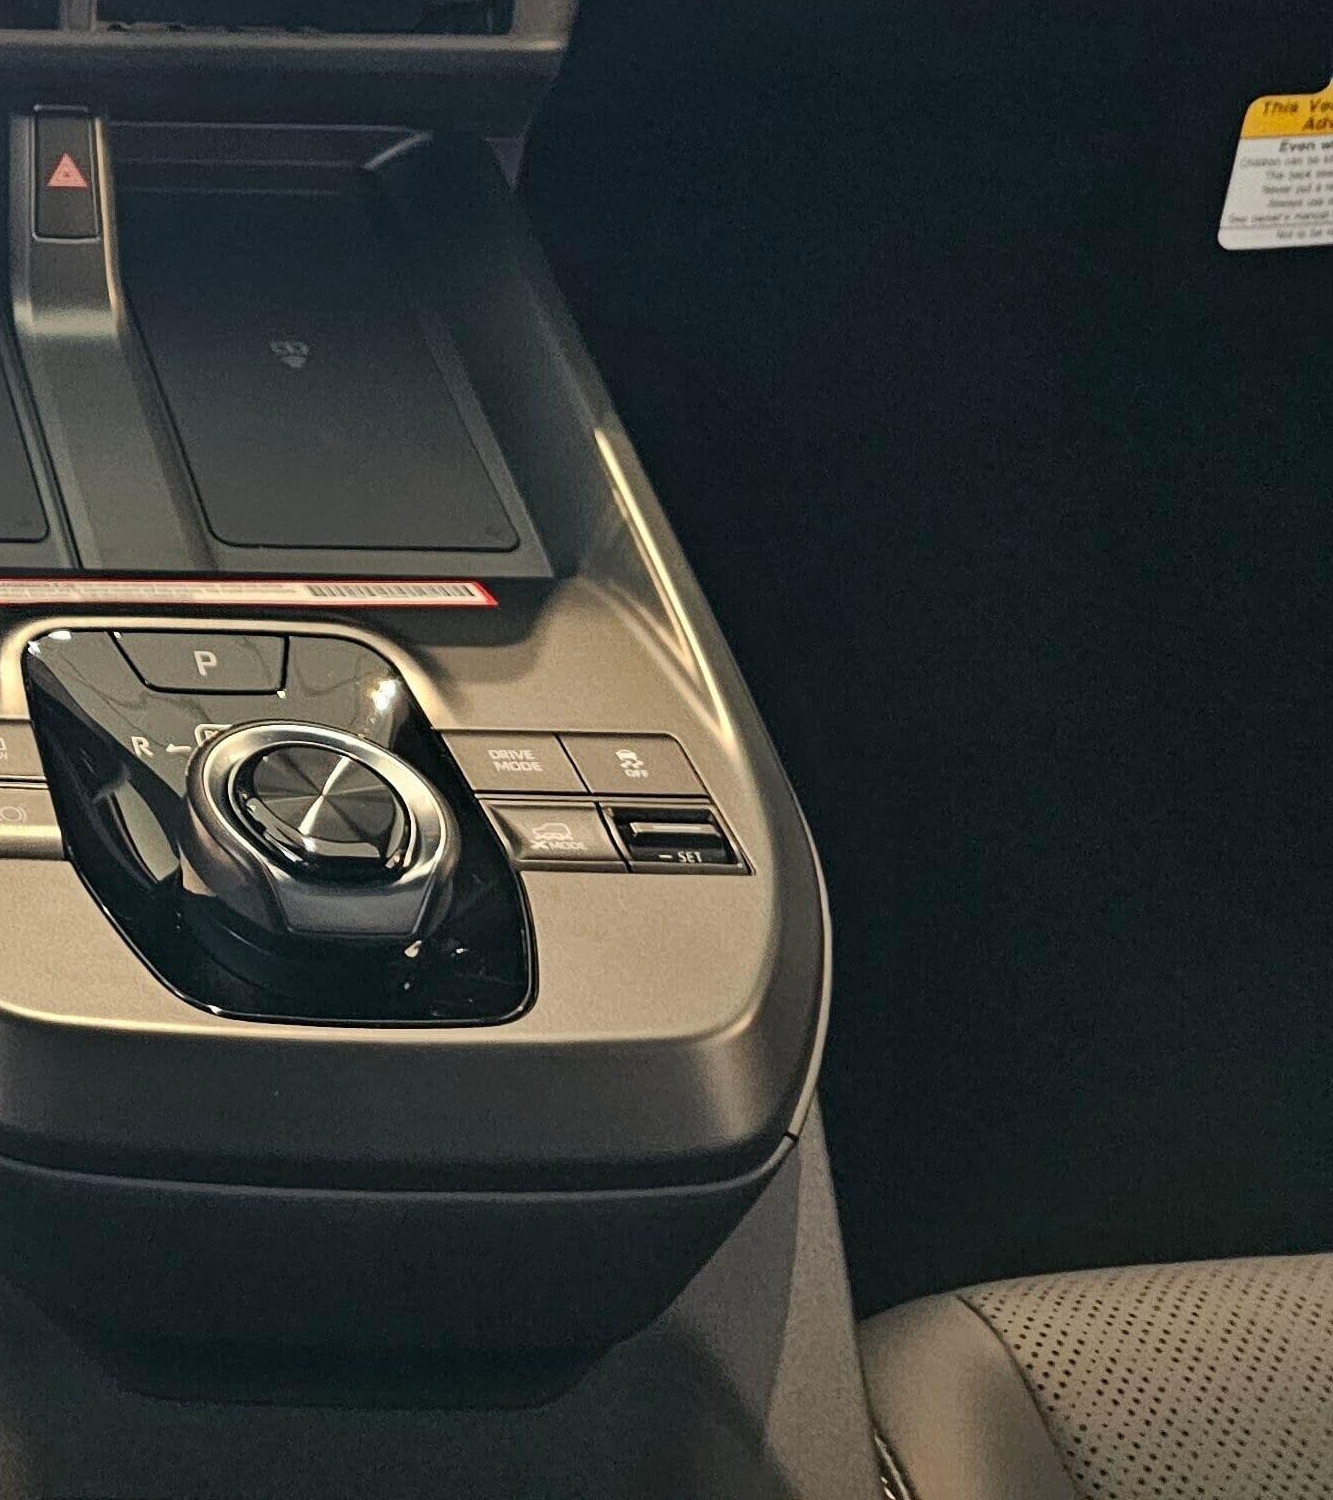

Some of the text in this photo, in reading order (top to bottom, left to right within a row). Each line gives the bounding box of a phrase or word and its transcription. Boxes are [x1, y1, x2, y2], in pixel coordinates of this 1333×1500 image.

[194, 650, 218, 677] P
[131, 736, 155, 757] R
[488, 749, 536, 761] DRIVE
[493, 761, 544, 773] MODE
[677, 851, 703, 864] SET
